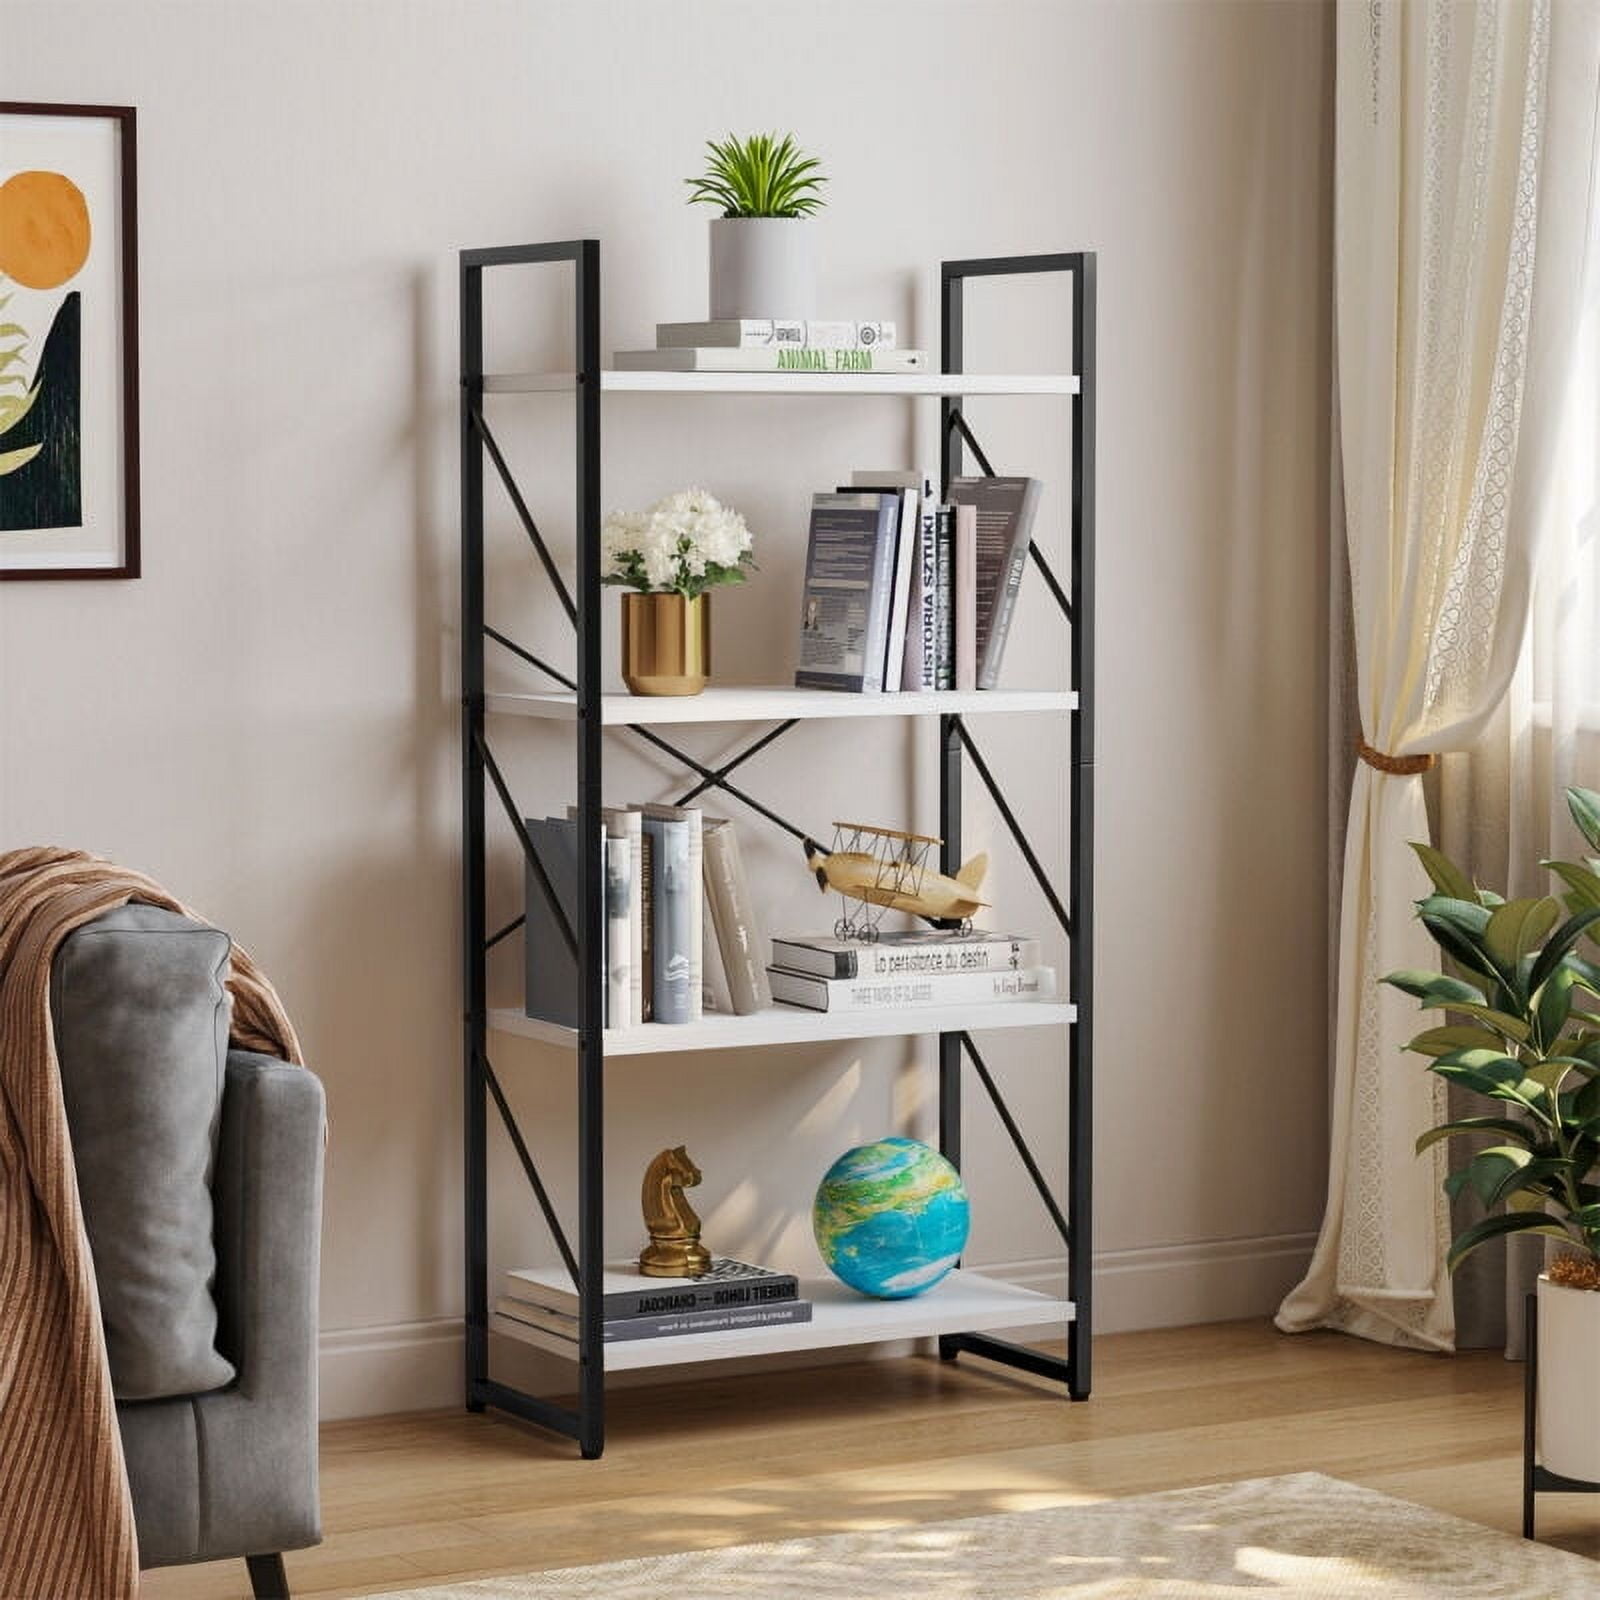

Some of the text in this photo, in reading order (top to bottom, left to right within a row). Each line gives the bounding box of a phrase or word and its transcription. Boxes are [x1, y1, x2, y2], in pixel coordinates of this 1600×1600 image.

[777, 349, 873, 369] ANIMAL FARM
[921, 514, 935, 688] HISTORIA SZTUKI
